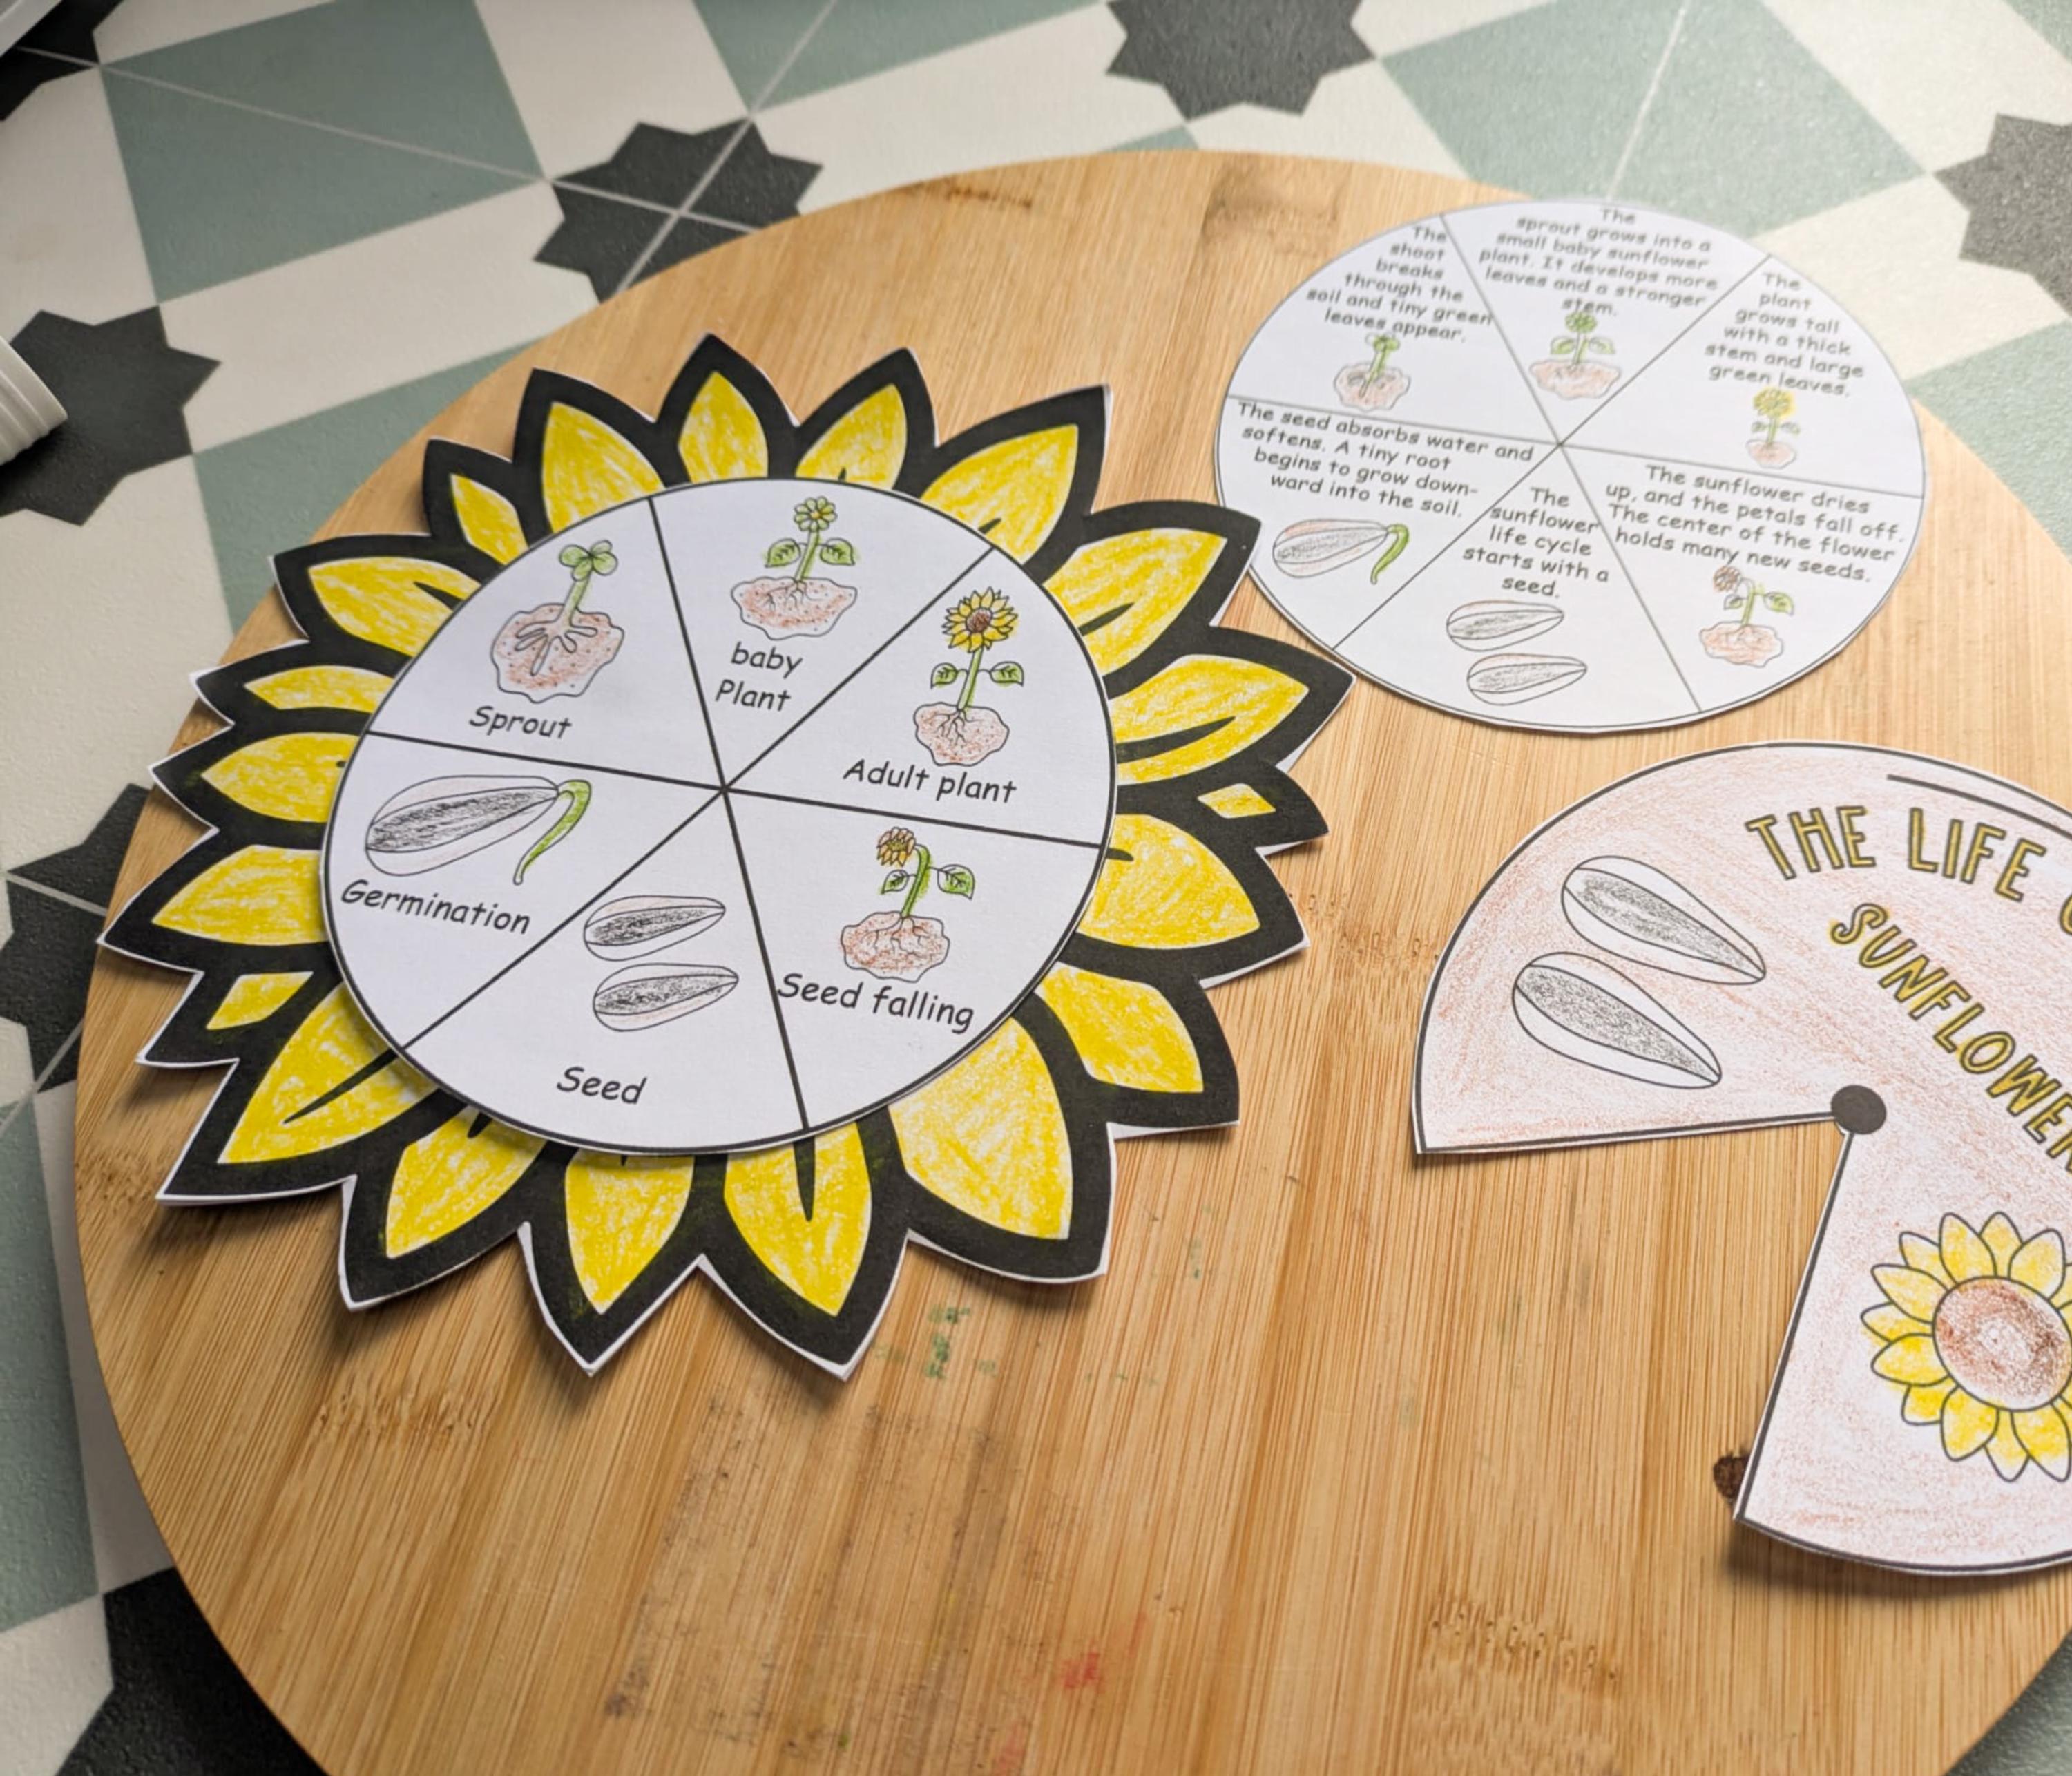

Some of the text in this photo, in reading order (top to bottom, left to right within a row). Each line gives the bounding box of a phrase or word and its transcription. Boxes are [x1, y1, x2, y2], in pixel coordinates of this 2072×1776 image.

[1517, 216, 1711, 251] sprout grows into a
[1601, 209, 1636, 224] The
[1390, 242, 1445, 260] shoot
[1412, 226, 1446, 243] The
[1497, 233, 1709, 269] small baby sunflower
[1376, 260, 1443, 279] breaks
[1479, 248, 1718, 290] plant. It develops more
[1763, 271, 1801, 291] The
[1345, 274, 1463, 302] through the
[1486, 267, 1706, 308] leaves and a stronger
[1758, 292, 1811, 312] plant
[1307, 287, 1492, 326] soil and tiny green
[1562, 298, 1617, 316] stem.
[1735, 308, 1839, 334] grows tall
[1325, 309, 1466, 342] leaves appear.
[1723, 326, 1851, 355] with a thick
[1705, 344, 1863, 379] stem and large
[1709, 364, 1850, 397] green leaves.
[1238, 403, 1535, 462] The seed absorbs water and
[1242, 426, 1451, 471] softens. A tiny root
[1254, 448, 1478, 496] begins to grow down-
[1646, 465, 1870, 514] The sunflower dries
[1271, 475, 1462, 517] ward into the soil.
[1531, 486, 1570, 507] The
[1606, 483, 1904, 543] up, and the petals fall off.
[1490, 506, 1600, 534] sunflower
[1608, 503, 1895, 562] The center of the flower
[1490, 524, 1591, 556] life cycle
[1615, 527, 1871, 582] holds many new seeds.
[1462, 547, 1609, 582] starts with a
[1501, 576, 1560, 599] seed.
[730, 642, 803, 679] baby
[715, 678, 792, 712] Plant
[469, 705, 573, 738] Sprout
[842, 759, 1017, 803] Adult plant
[1745, 805, 2047, 902] THE LIFE
[340, 879, 530, 934] Germination
[778, 973, 975, 1034] Seed falling
[556, 1066, 647, 1105] Seed
